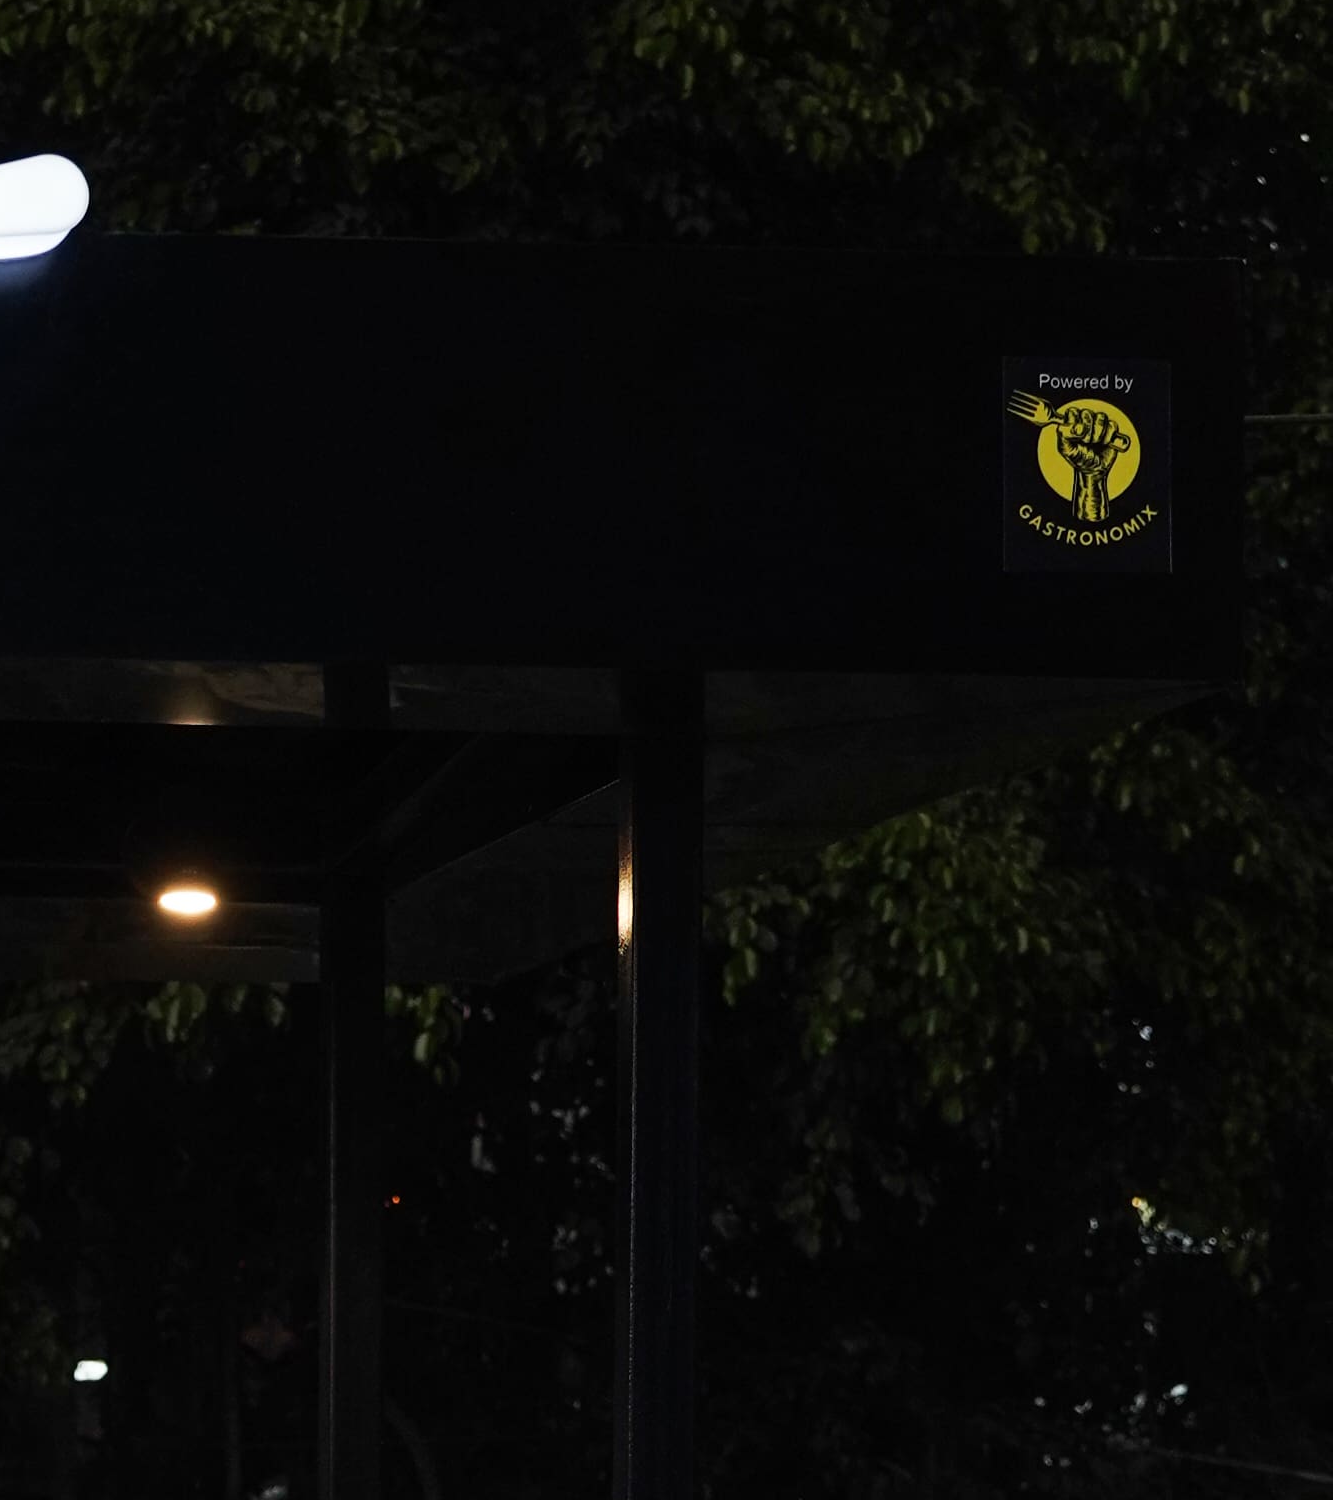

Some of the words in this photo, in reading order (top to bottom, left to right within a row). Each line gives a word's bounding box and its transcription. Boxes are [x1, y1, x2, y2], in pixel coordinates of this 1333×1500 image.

[1039, 373, 1109, 389] Powered
[1114, 374, 1134, 394] by
[1018, 504, 1158, 546] GASTRONOMIX
